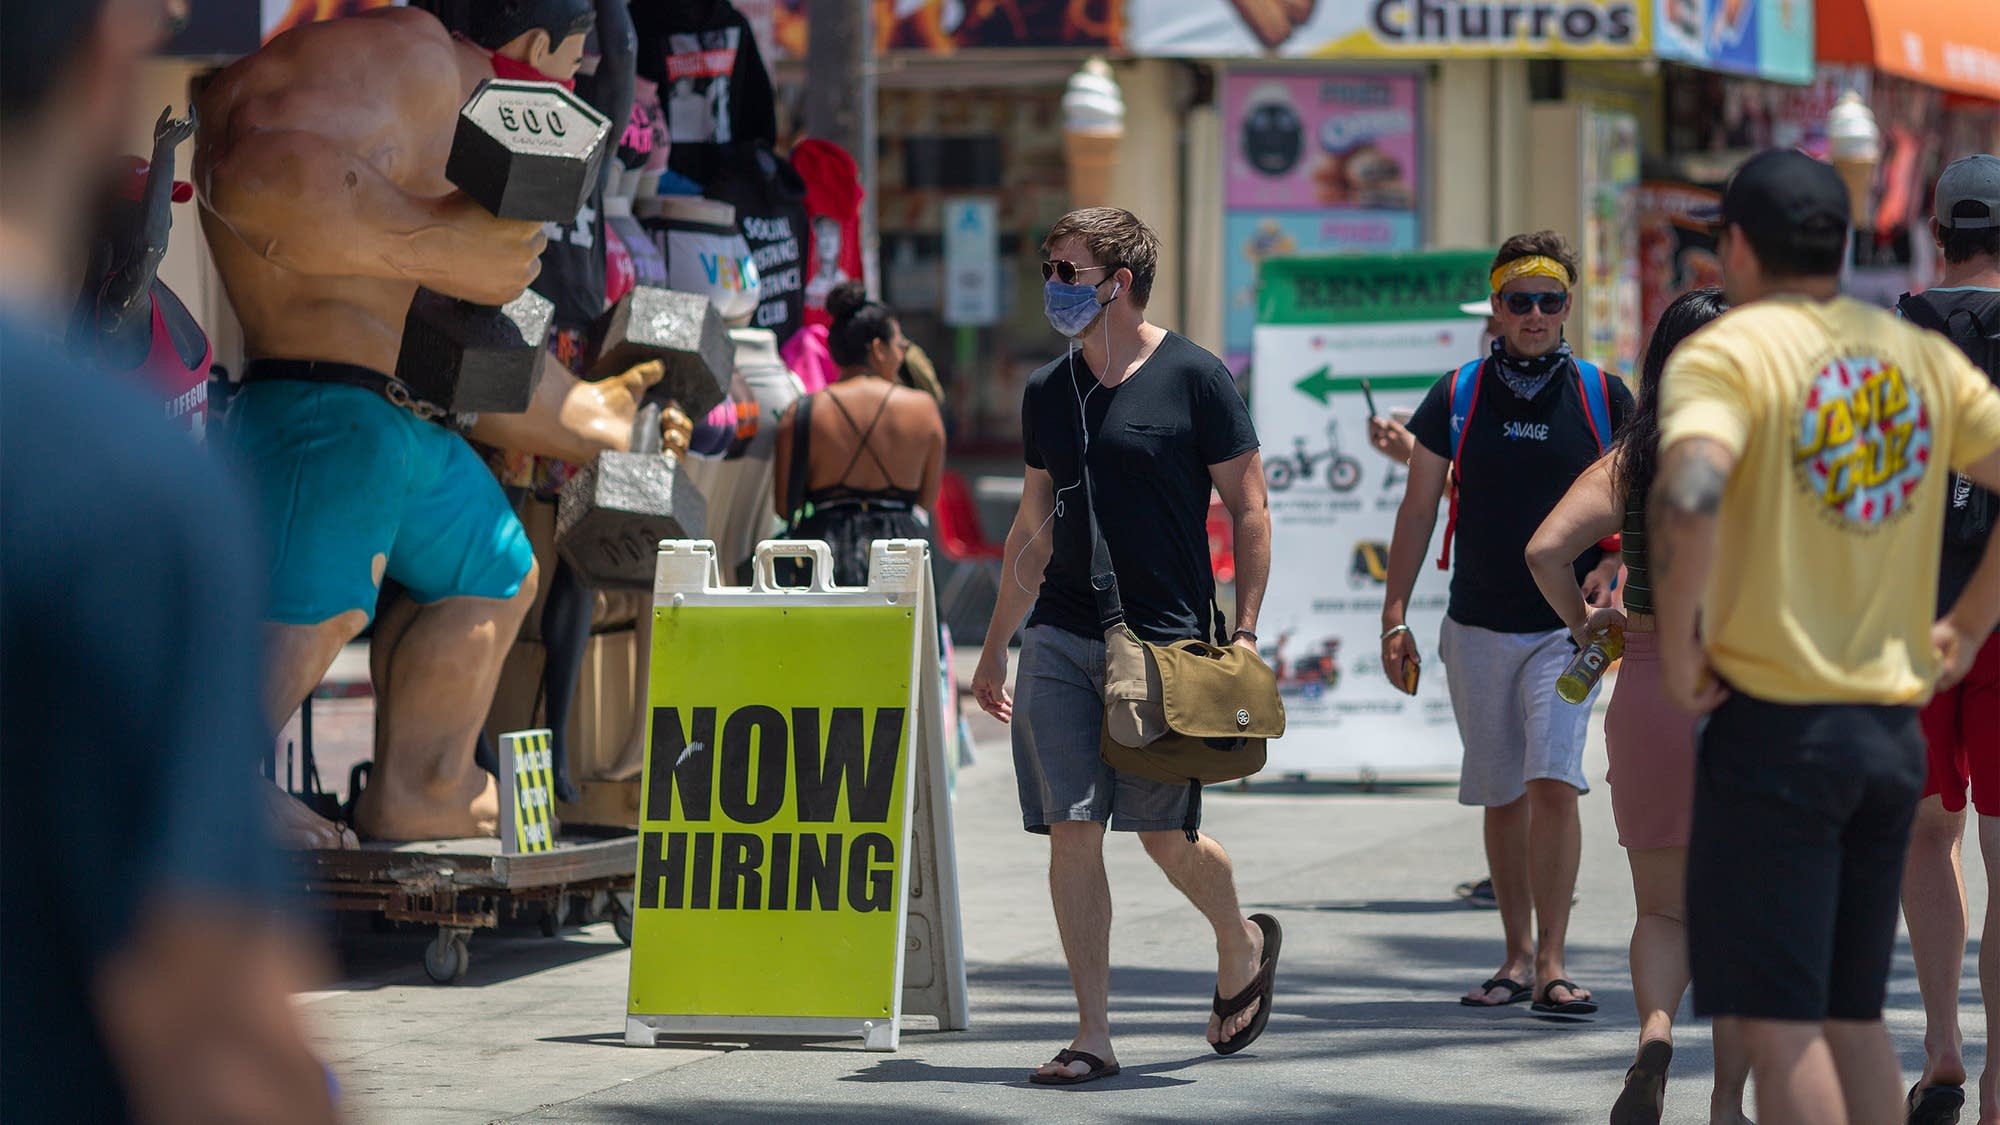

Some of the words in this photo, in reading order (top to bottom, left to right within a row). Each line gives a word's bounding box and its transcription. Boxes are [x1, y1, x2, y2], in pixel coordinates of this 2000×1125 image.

[1373, 0, 1632, 41] Churros
[498, 104, 567, 138] 500
[1294, 267, 1485, 308] RENTALS
[1503, 421, 1549, 440] SAVAGE
[647, 704, 905, 824] NOW
[639, 832, 895, 913] HIRING
